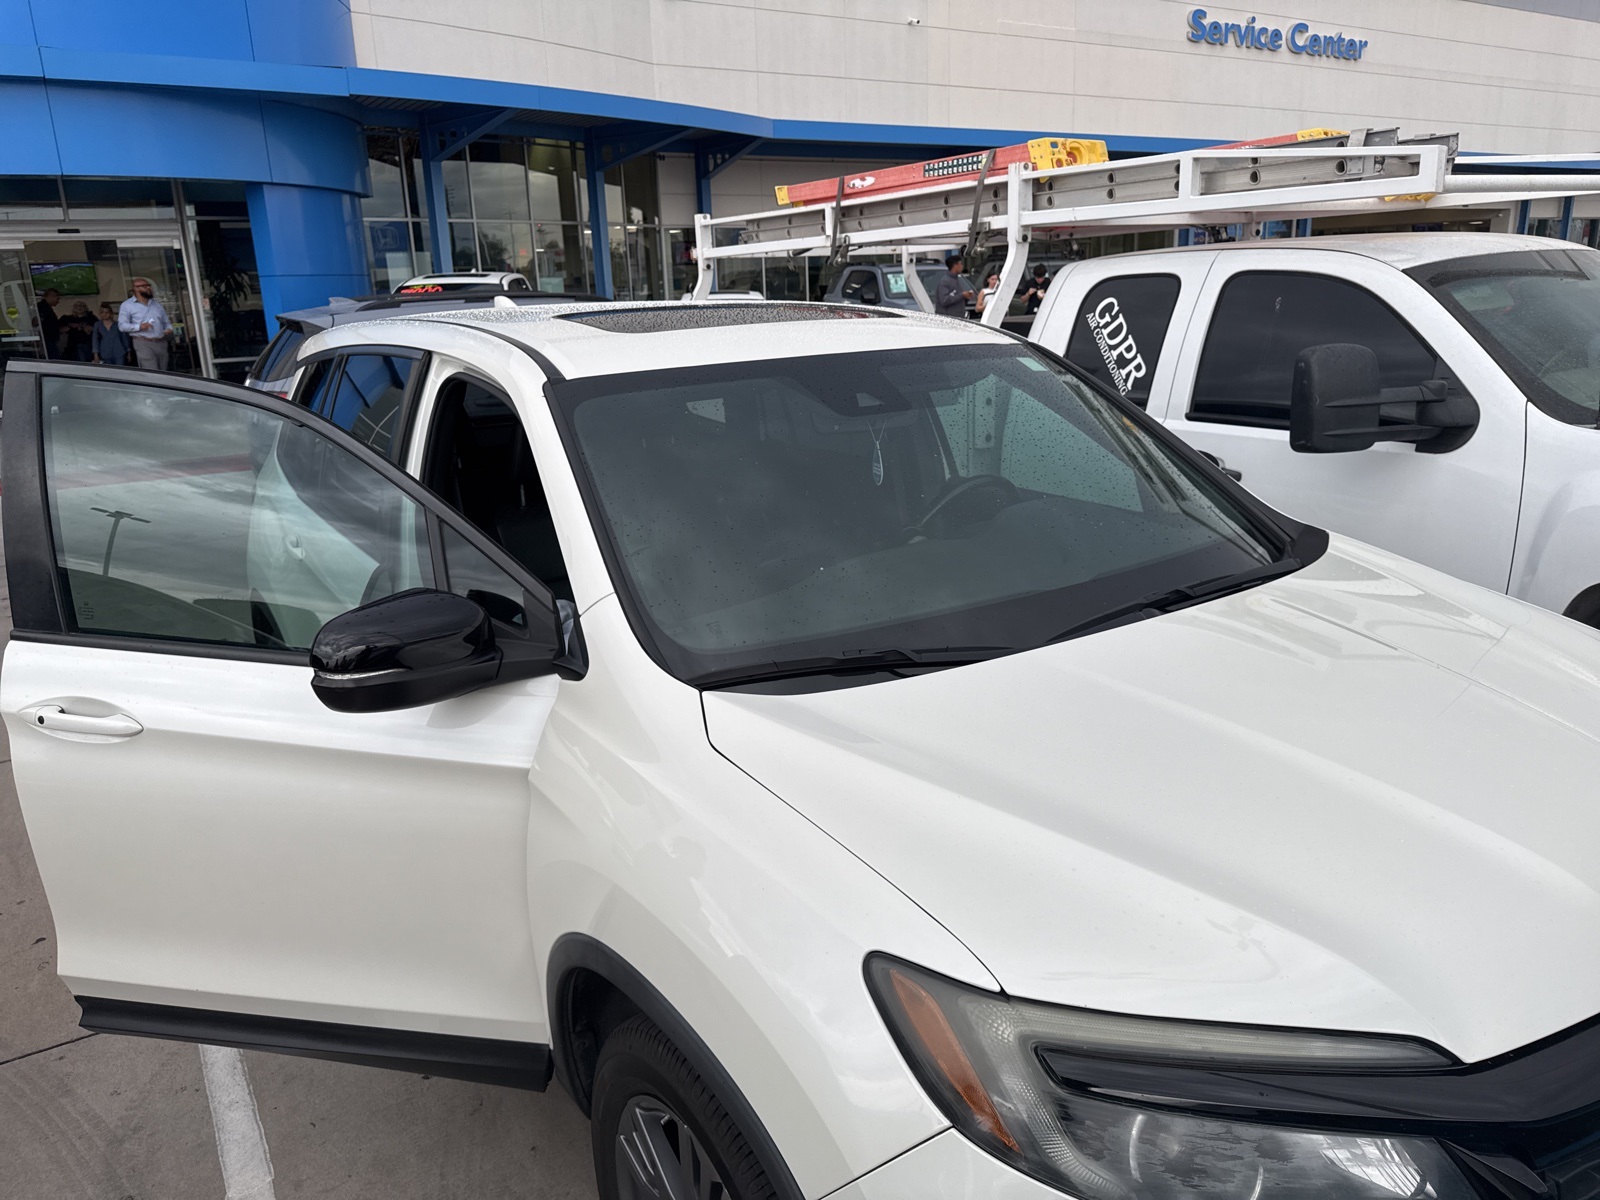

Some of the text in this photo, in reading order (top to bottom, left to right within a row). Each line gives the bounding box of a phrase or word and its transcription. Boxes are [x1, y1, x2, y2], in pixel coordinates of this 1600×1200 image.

[1187, 8, 1368, 60] Service Center
[1086, 312, 1129, 396] AIR CONDITIONING
[1095, 297, 1146, 391] GDPR
